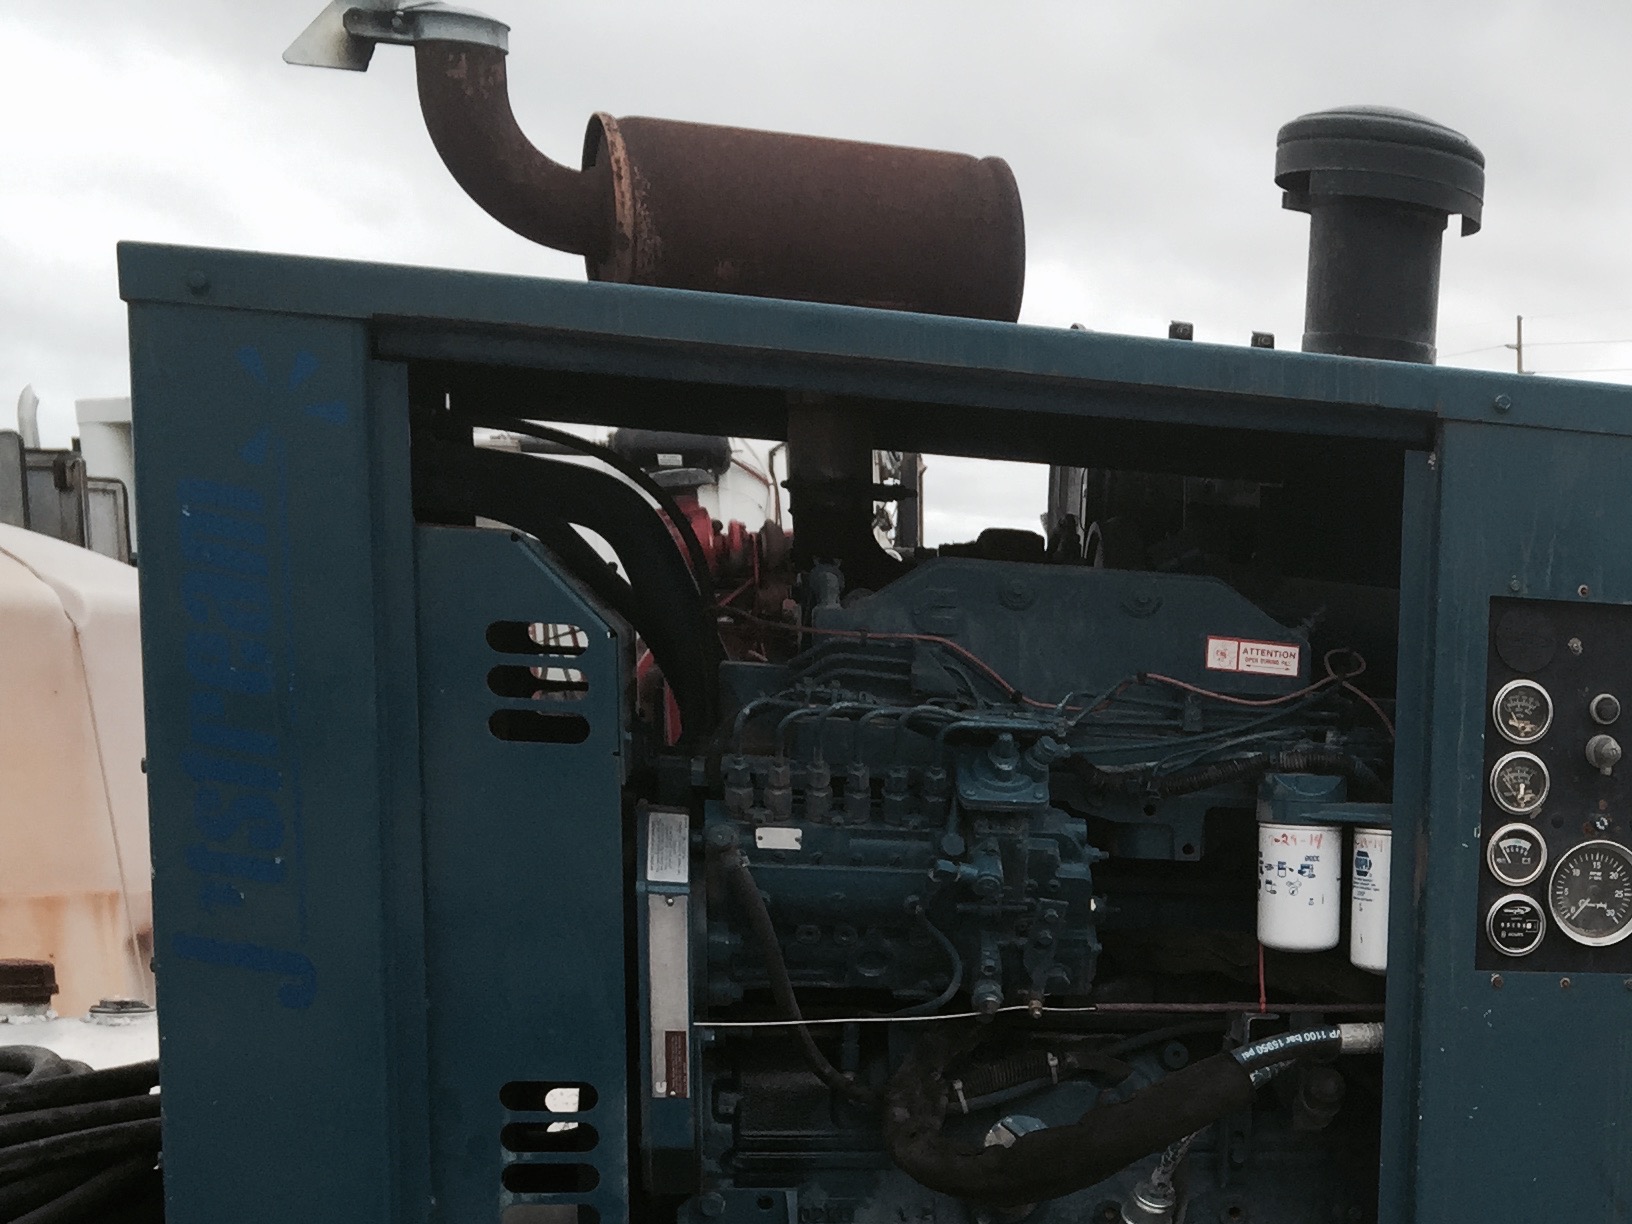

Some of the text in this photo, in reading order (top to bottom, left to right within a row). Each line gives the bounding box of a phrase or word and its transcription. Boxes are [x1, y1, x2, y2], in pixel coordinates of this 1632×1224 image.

[1242, 647, 1297, 660] ATTENTION
[1592, 861, 1602, 870] 15
[1614, 889, 1624, 898] 25
[1286, 1034, 1303, 1044] bar
[1303, 1031, 1327, 1042] 1100
[1241, 1047, 1256, 1061] psi
